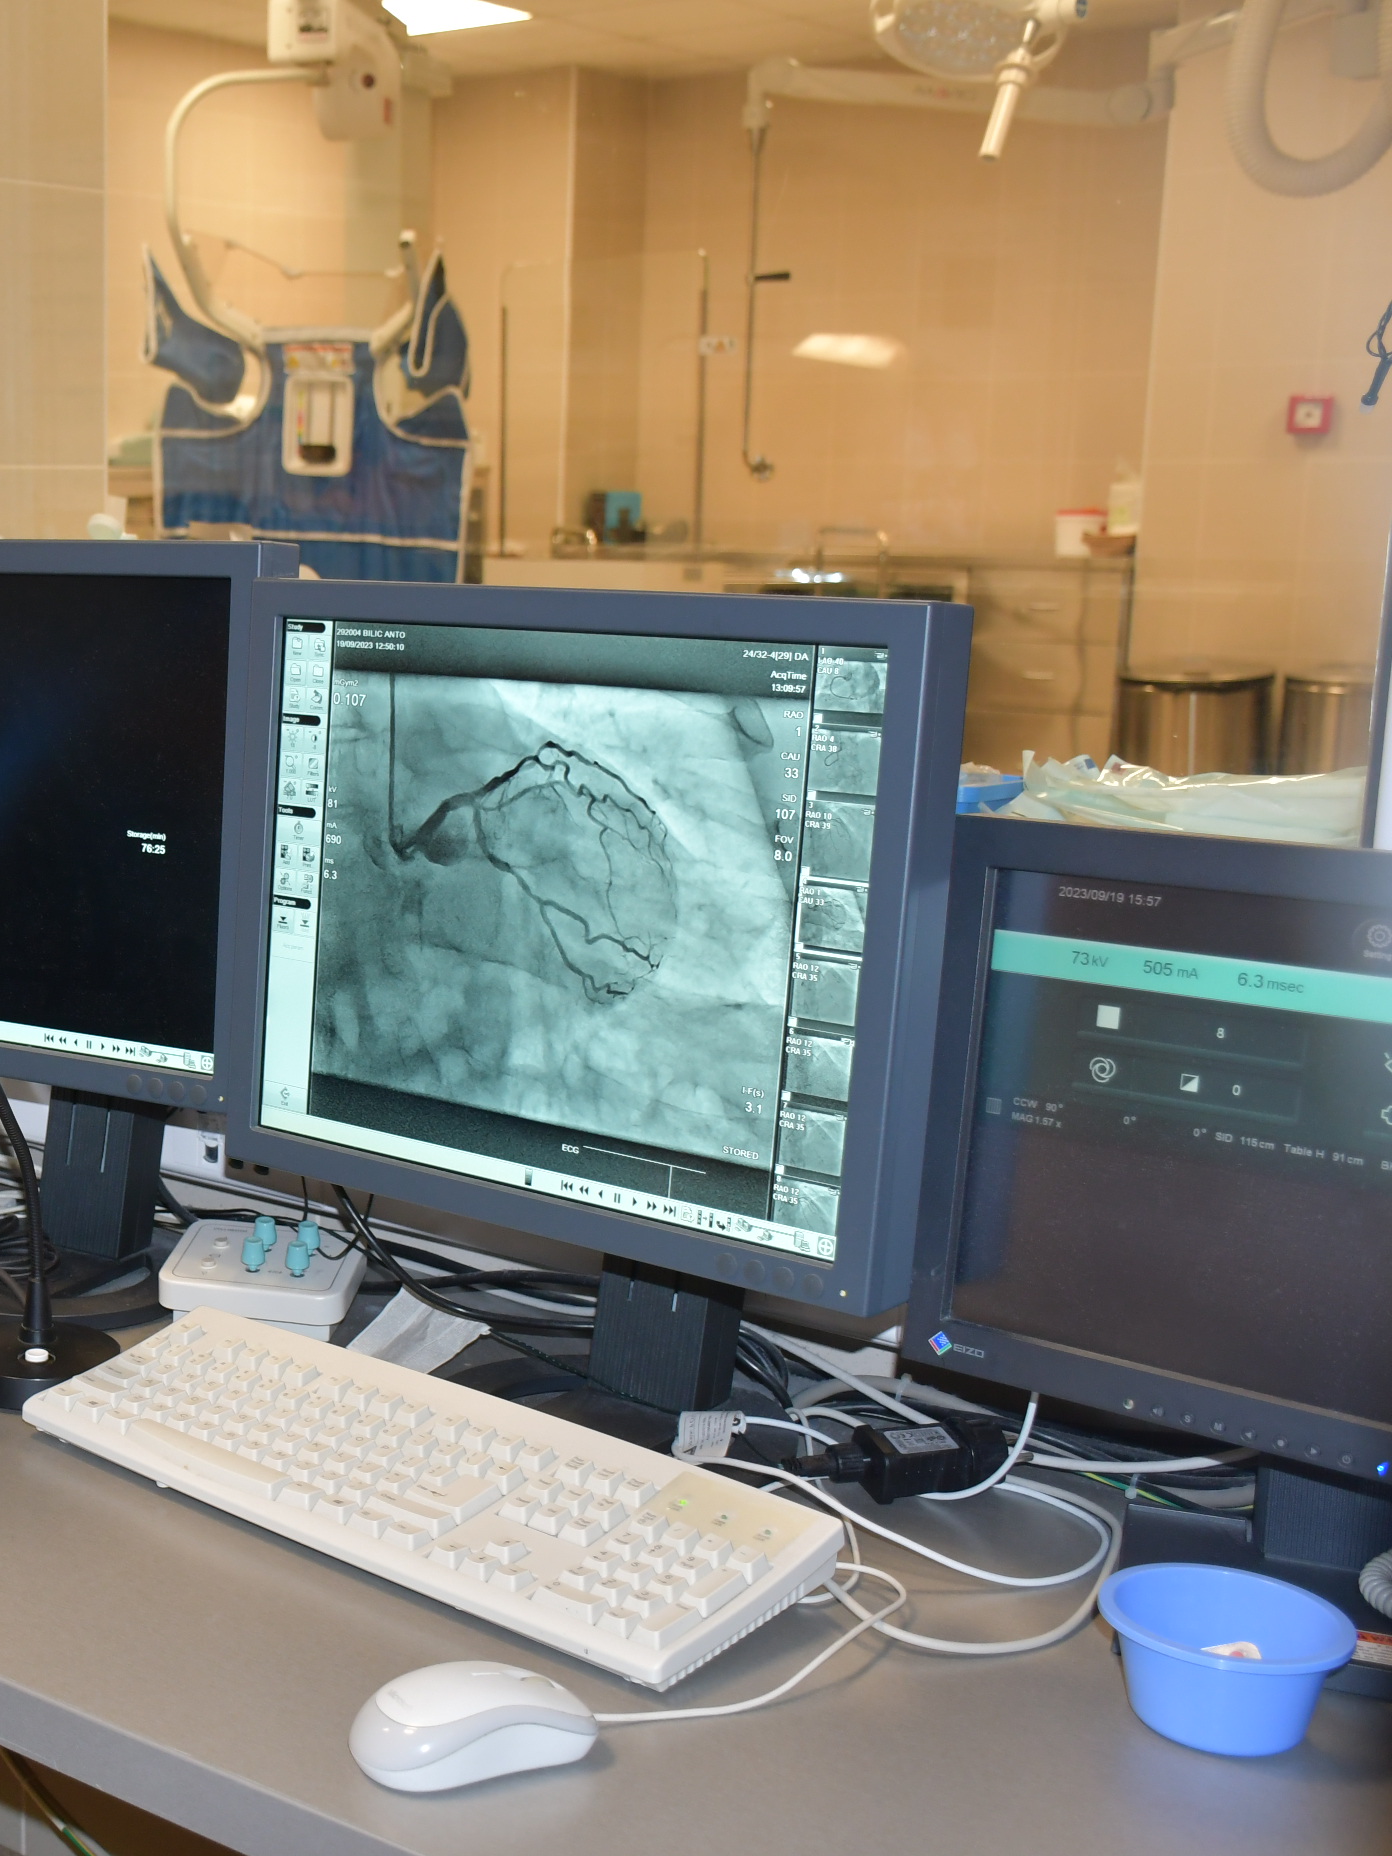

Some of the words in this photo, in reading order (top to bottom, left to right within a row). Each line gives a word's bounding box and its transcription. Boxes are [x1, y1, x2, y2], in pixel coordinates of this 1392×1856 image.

[288, 623, 303, 631] Study
[336, 628, 361, 637] 292004
[363, 629, 383, 638] BILIC
[384, 630, 406, 639] ANTO
[336, 640, 373, 649] 19/09/2023
[743, 650, 792, 662] 24/32-4[29]
[795, 652, 809, 662] DA
[770, 670, 807, 682] AcqTime
[817, 666, 833, 675] CAU
[771, 683, 806, 694] 13:09:57
[333, 692, 367, 707] 0.107
[283, 716, 300, 724] Image
[783, 710, 804, 719] RAO
[796, 726, 801, 737] 1
[812, 734, 828, 742] RAO
[811, 744, 826, 752] CRA
[781, 752, 801, 761] CAU
[784, 767, 799, 779] 33
[327, 799, 338, 808] 81
[782, 794, 797, 803] SID
[278, 806, 293, 814] Tools
[775, 808, 796, 820] 107
[805, 811, 821, 819] RAO
[823, 812, 832, 820] 10
[805, 820, 820, 828] CRA
[127, 830, 167, 842] Storage(min)
[325, 834, 342, 845] 690
[775, 835, 794, 843] FOV
[141, 842, 166, 854] 76:25
[774, 849, 793, 861] 8.0
[323, 869, 338, 880] 6.3
[800, 887, 815, 895] RAO
[1059, 886, 1125, 903] 2023/09/19
[1128, 893, 1162, 907] 15:57
[273, 897, 296, 905] Program
[799, 897, 814, 905] CAU
[793, 962, 808, 970] RAO
[811, 965, 819, 973] 12
[1143, 960, 1173, 977] 505
[1176, 967, 1199, 980] mA
[792, 972, 807, 980] CRA
[1237, 972, 1265, 989] 6.3
[1266, 980, 1305, 994] msec
[1216, 1027, 1225, 1039] 8
[786, 1036, 802, 1045] RAO
[785, 1046, 801, 1055] CRA
[1232, 1085, 1241, 1096] 0
[745, 1102, 762, 1114] 3.1
[1013, 1097, 1038, 1109] CCW
[780, 1111, 795, 1119] RAO
[1011, 1111, 1034, 1123] MAG
[779, 1120, 794, 1129] CRA
[561, 1143, 580, 1154] ECG
[722, 1145, 759, 1160] STORED
[1215, 1132, 1234, 1143] SID
[1284, 1143, 1313, 1157] Table
[1315, 1150, 1325, 1160] H
[1332, 1151, 1345, 1163] 91
[1346, 1156, 1364, 1166] cm
[773, 1184, 788, 1193] RAO
[791, 1187, 799, 1195] 12
[772, 1193, 787, 1202] CRA
[789, 1196, 798, 1204] 35
[953, 1343, 985, 1358] EIZO
[1184, 1414, 1191, 1423] S
[1214, 1422, 1223, 1431] M
